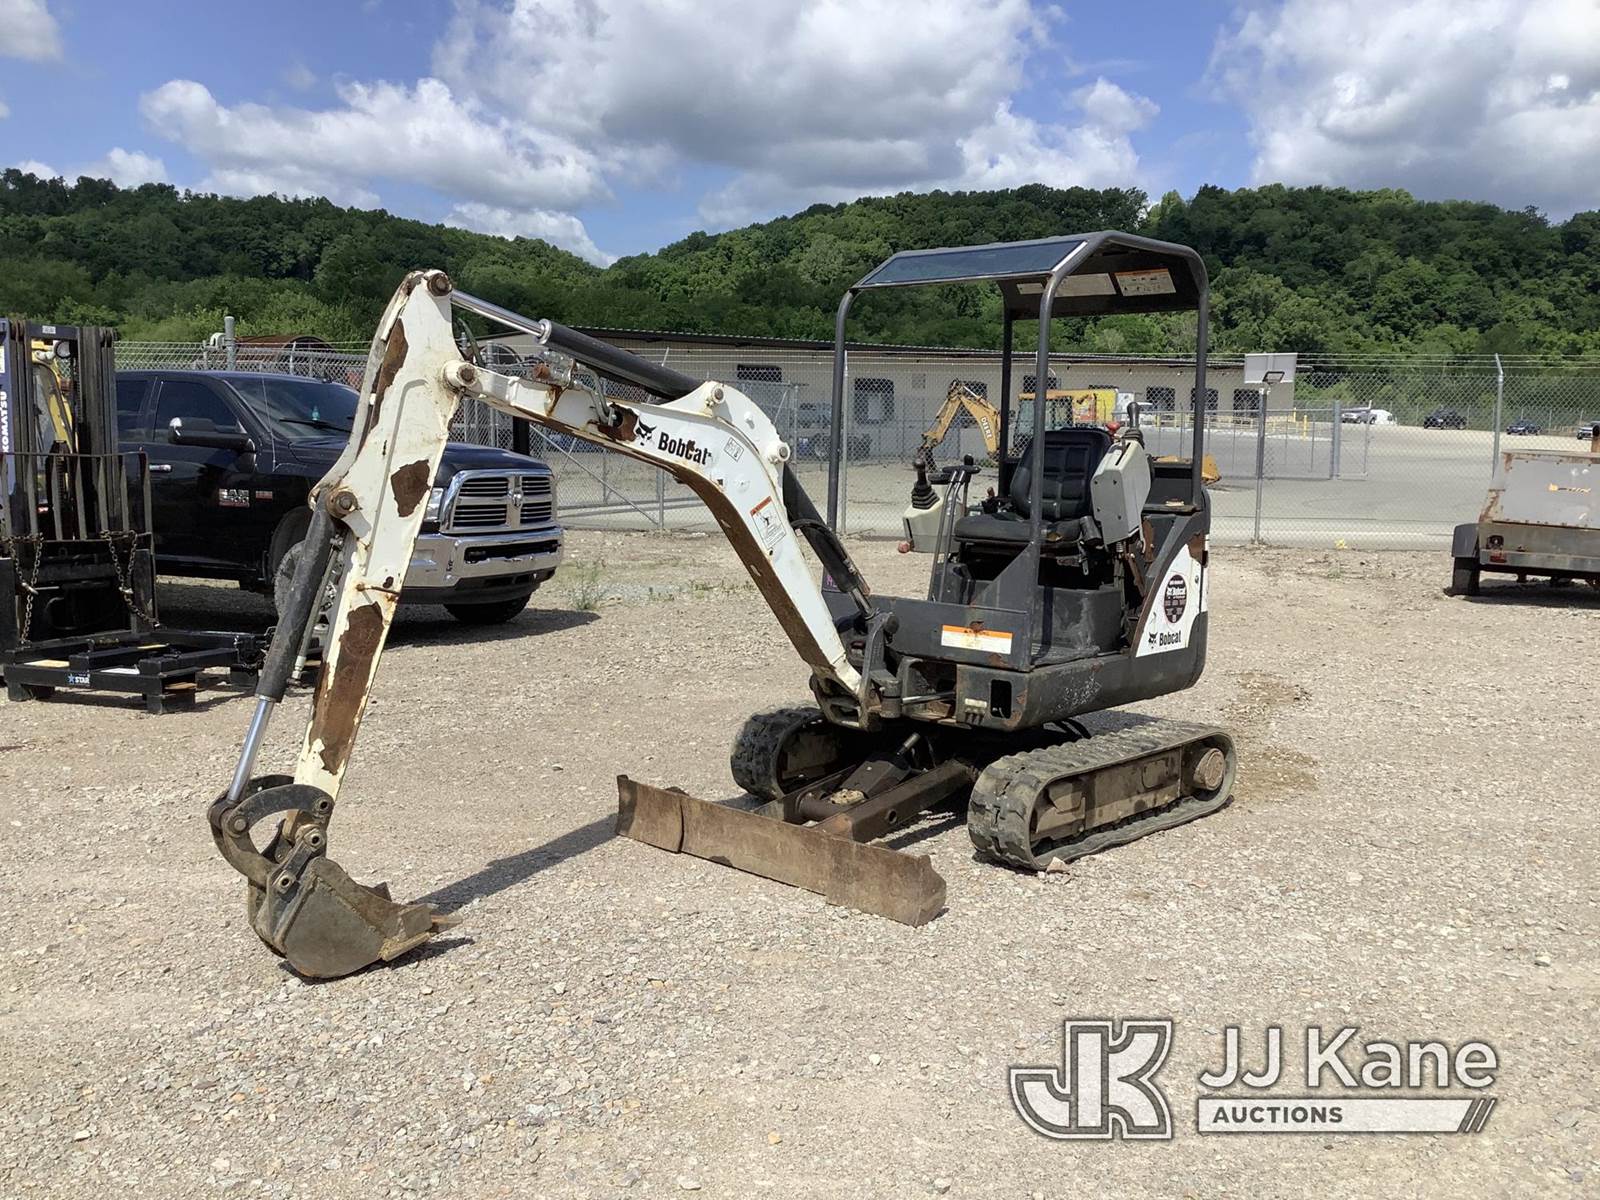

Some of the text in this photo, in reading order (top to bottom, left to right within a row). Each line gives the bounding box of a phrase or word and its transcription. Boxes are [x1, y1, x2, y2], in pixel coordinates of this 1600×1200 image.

[0, 391, 9, 453] KOMATSU
[981, 416, 993, 438] DEERE
[658, 432, 709, 465] Bobcat
[1160, 630, 1182, 646] Bobcat
